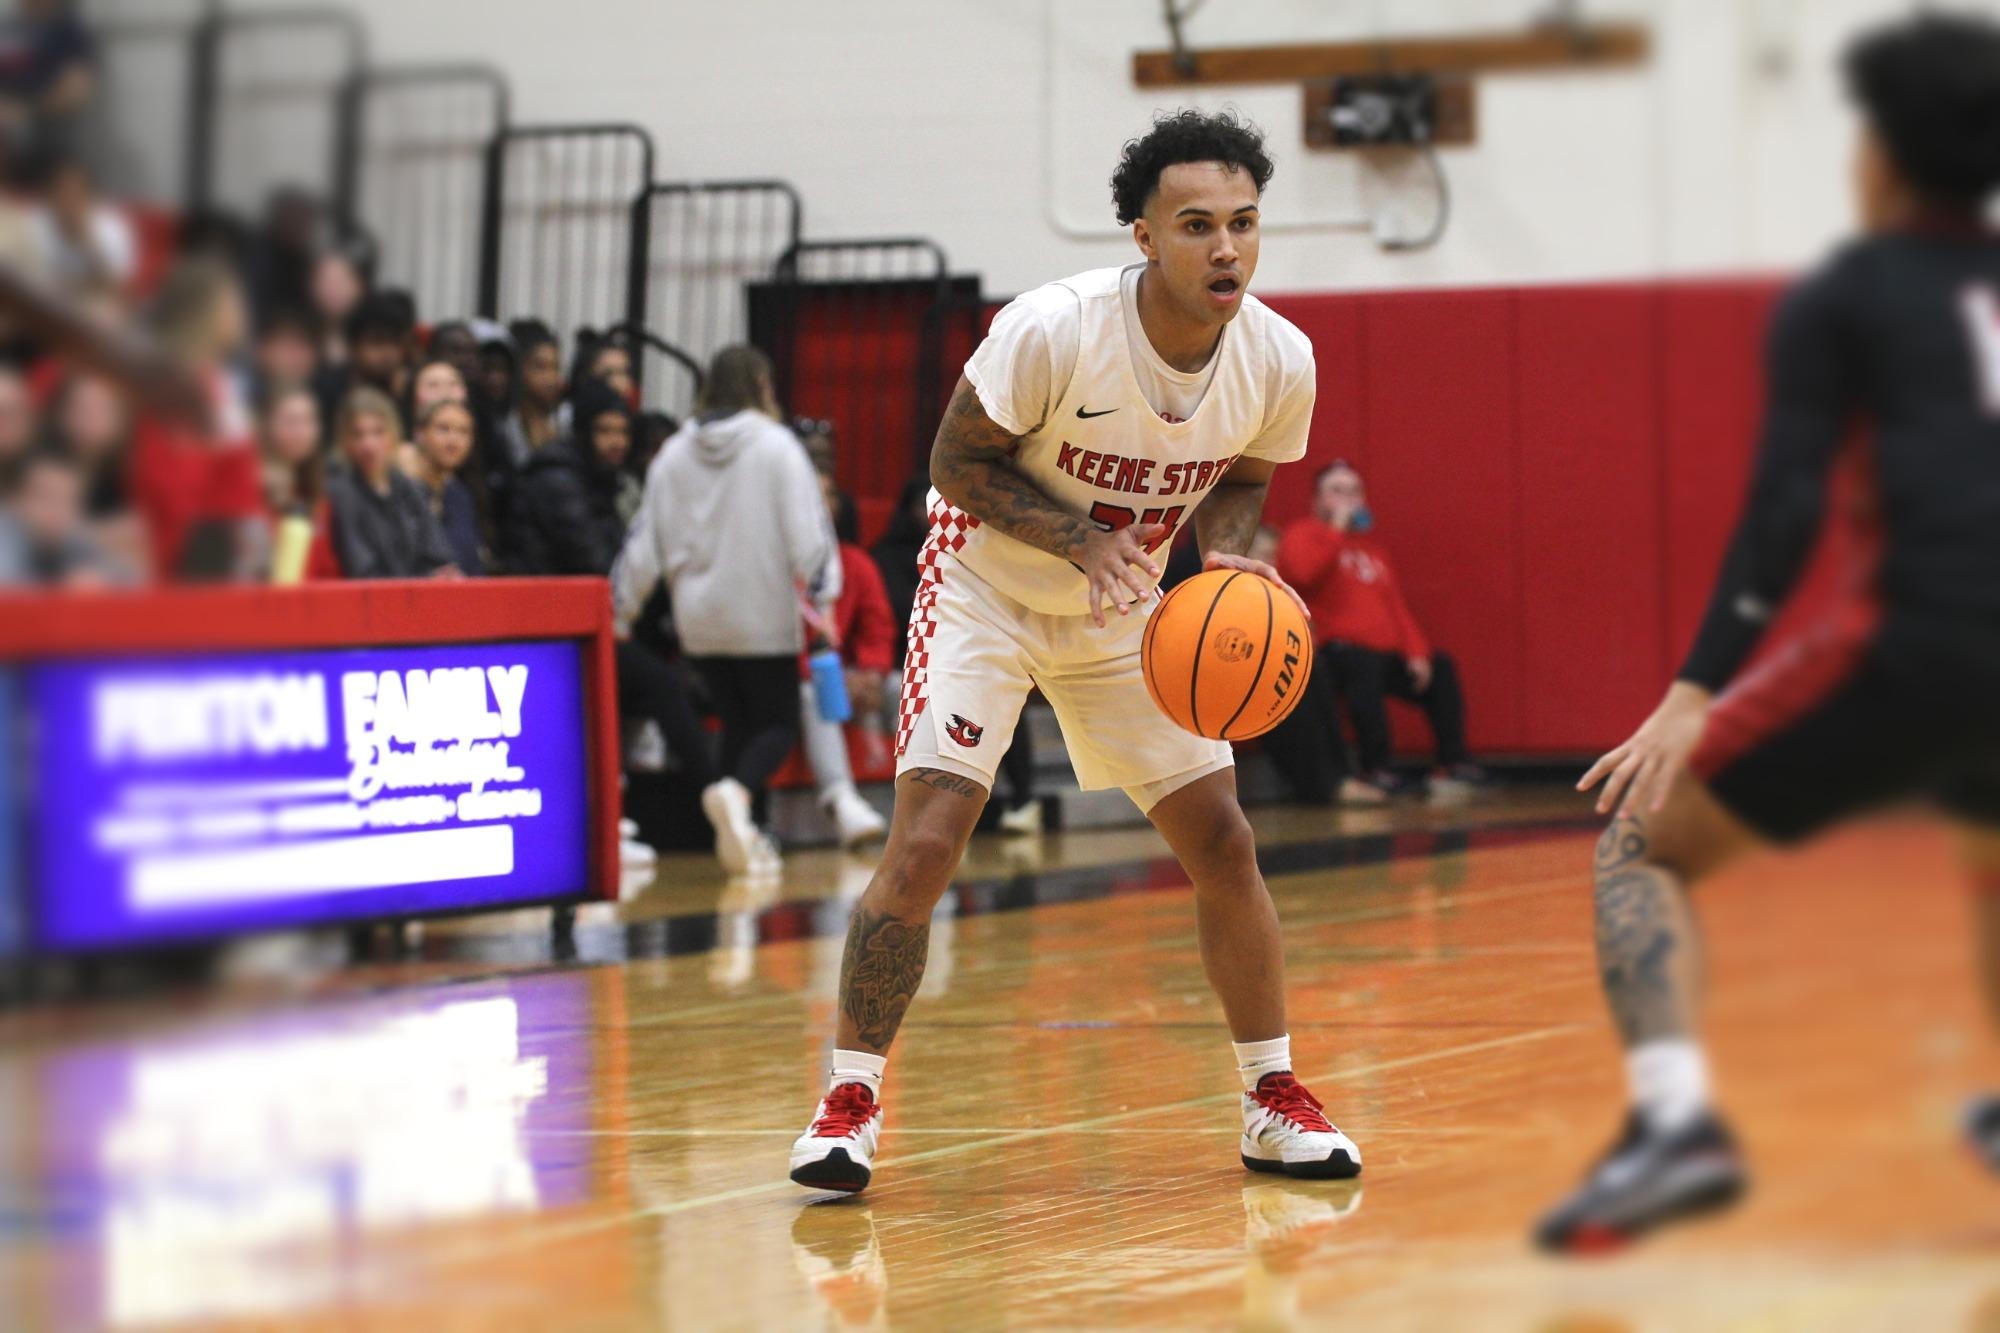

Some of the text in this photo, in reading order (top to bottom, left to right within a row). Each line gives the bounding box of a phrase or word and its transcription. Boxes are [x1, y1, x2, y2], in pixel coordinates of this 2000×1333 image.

[1056, 441, 1241, 495] KEENE STAT
[1274, 629, 1300, 699] EVO
[341, 664, 529, 742] FAMILY
